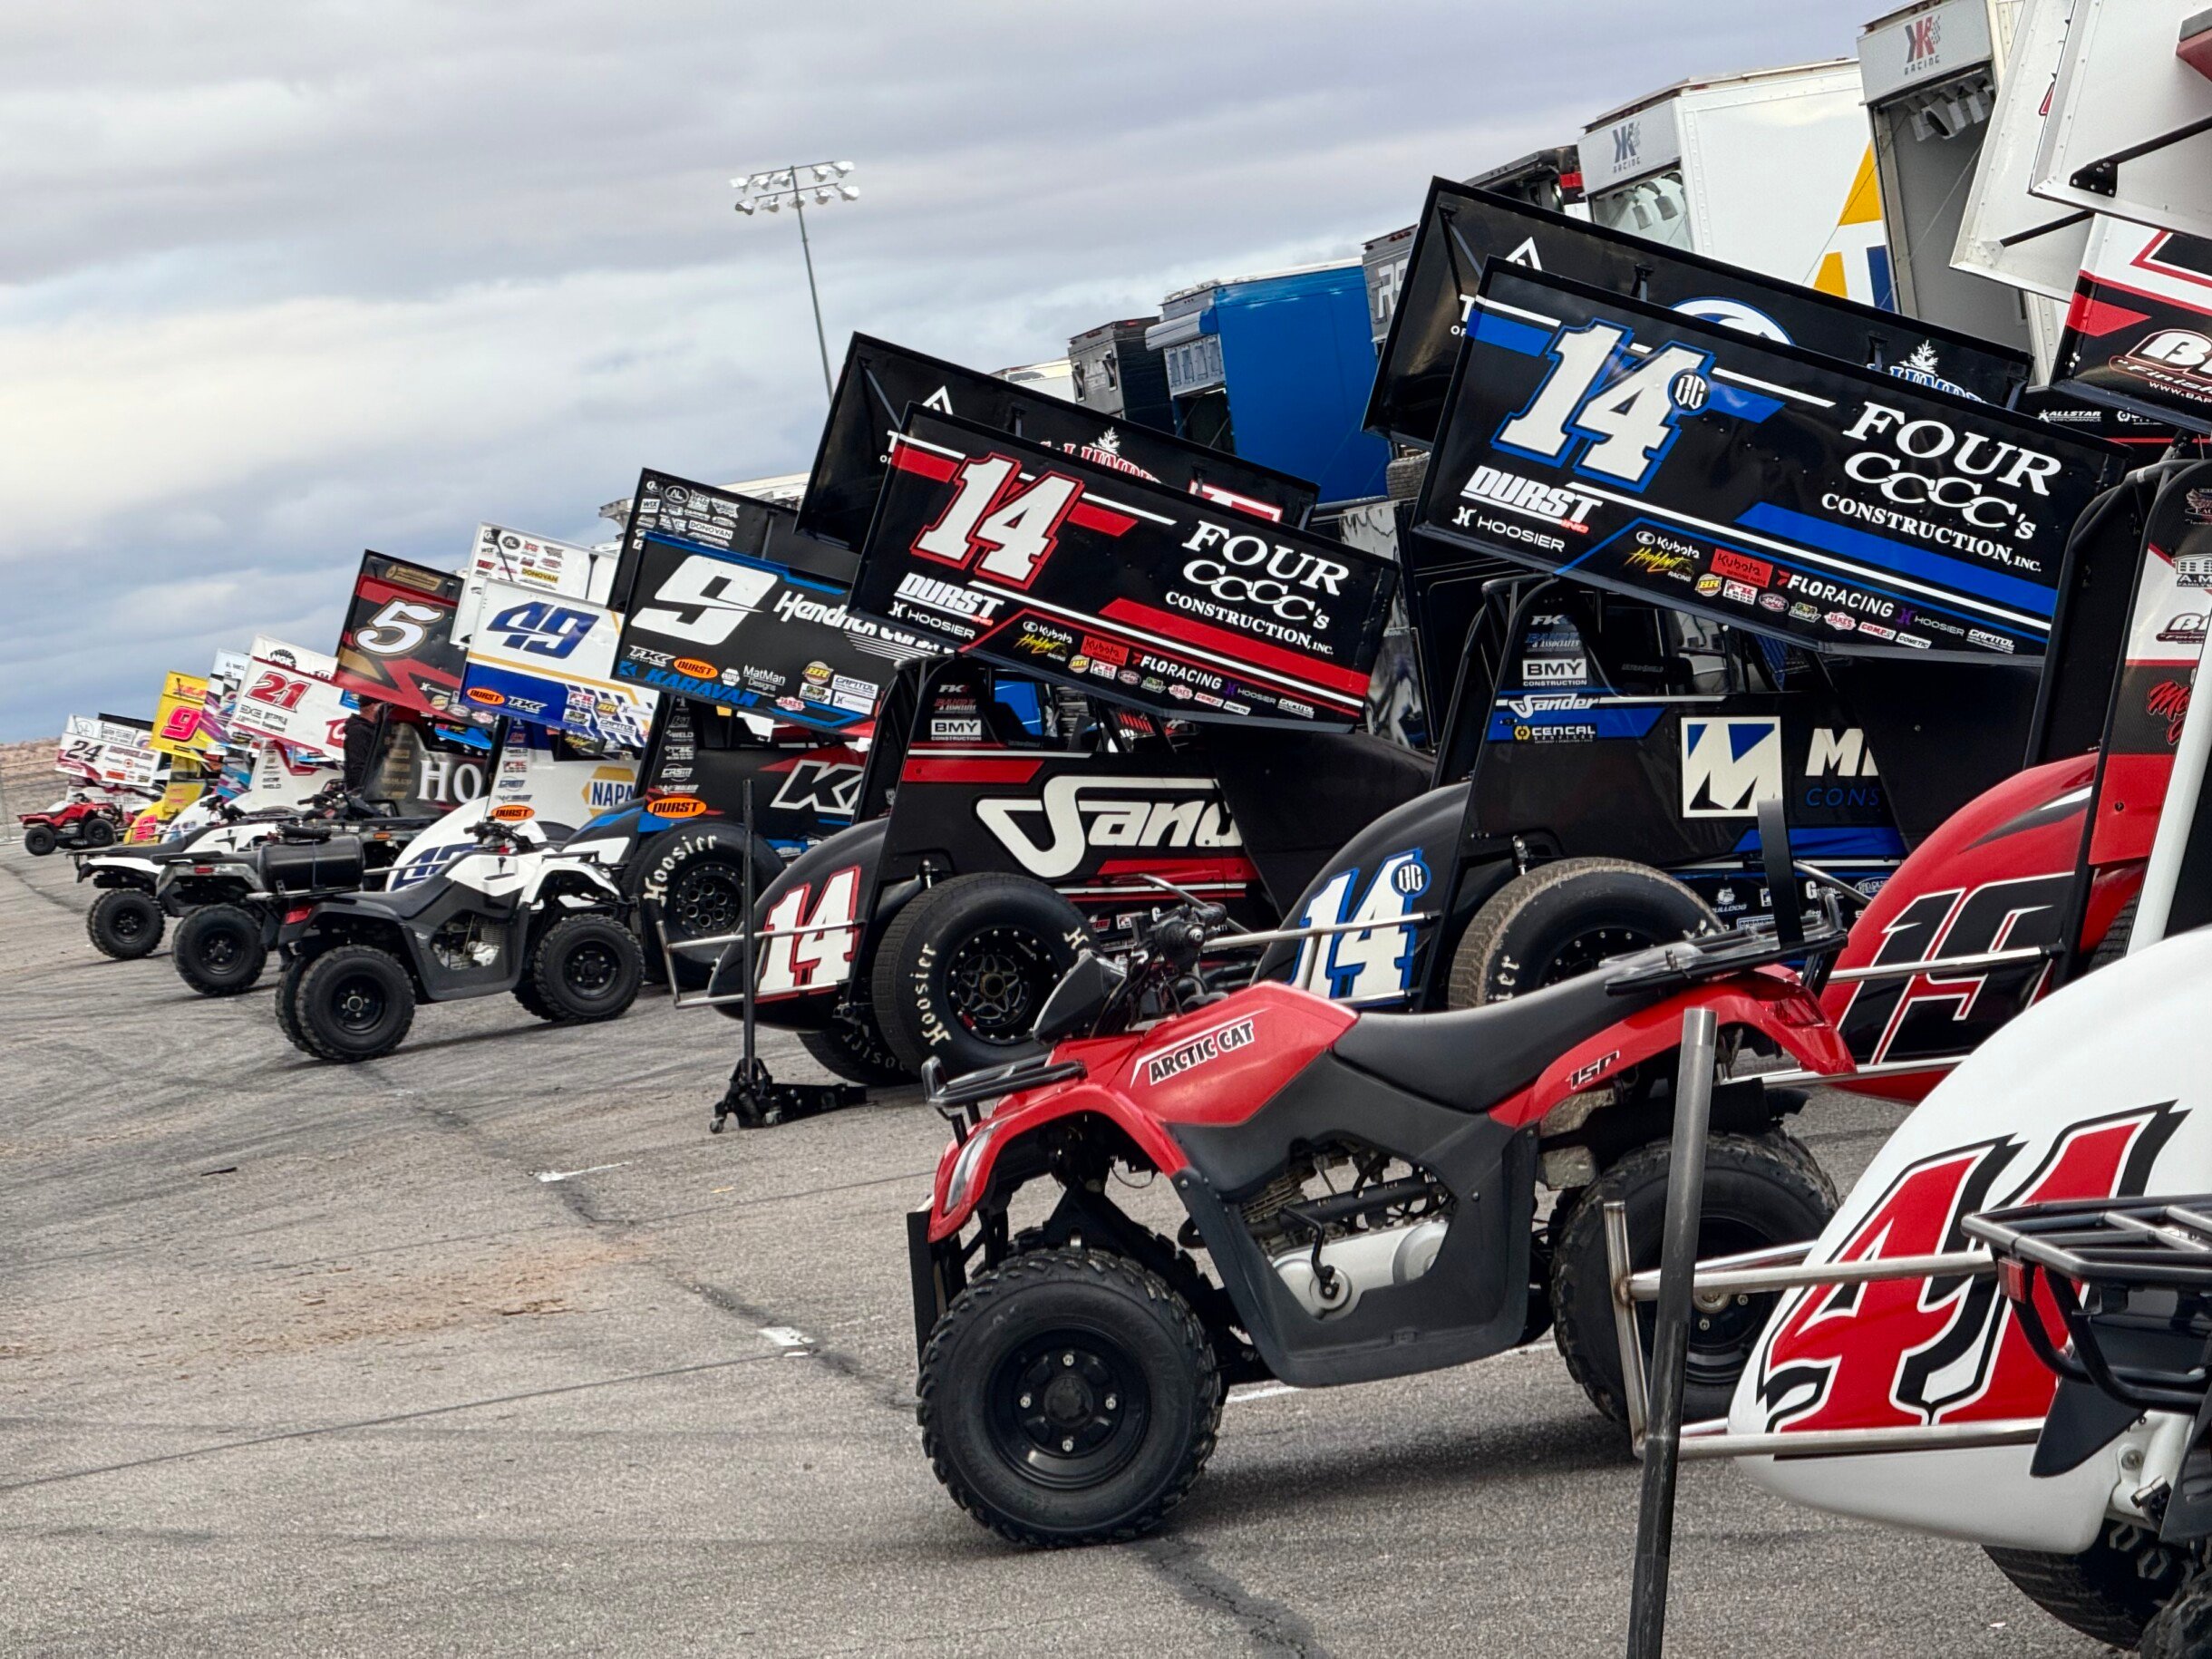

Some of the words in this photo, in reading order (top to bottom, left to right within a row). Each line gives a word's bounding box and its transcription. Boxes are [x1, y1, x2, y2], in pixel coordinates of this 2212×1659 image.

[1491, 318, 1716, 493] 14
[1843, 401, 2062, 497] FOUR
[1461, 465, 1604, 523] DURST
[690, 521, 732, 538] DONOVAN
[909, 452, 1086, 590] 14
[1477, 517, 1566, 552] HOOSIER
[1656, 536, 1700, 558] Kubota
[1181, 519, 1350, 597] FOUR
[1717, 553, 1762, 577] Kubota
[2014, 554, 2042, 572] INC.
[631, 555, 779, 645] 9
[894, 572, 1004, 619] DURST
[354, 595, 444, 655] 5
[486, 600, 600, 660] 49
[907, 610, 975, 640] HOOSIER
[1039, 625, 1073, 645] Kubota
[1915, 615, 1965, 636] HOOSIER
[1970, 628, 2015, 647] CAPITOL
[1312, 641, 1334, 655] INC.
[1898, 635, 1929, 648] COMETIC
[270, 655, 293, 667] NGK
[677, 660, 713, 675] DURST
[743, 664, 786, 684] MatMan
[1527, 662, 1583, 676] BMY
[245, 671, 312, 713] 21
[470, 689, 502, 703] DURST
[644, 668, 761, 708] KARAVAN
[1237, 687, 1276, 705] HOOSIER
[1509, 693, 1599, 719] Sander
[160, 705, 202, 742] 9
[935, 722, 978, 732] BMY
[64, 740, 105, 763] 24
[592, 781, 634, 807] NAPA
[653, 801, 701, 813] DURST
[495, 809, 529, 817] DURST
[755, 864, 861, 1002] 14
[1286, 847, 1425, 1008] 14
[1150, 1035, 1218, 1084] ARCTIC
[1218, 1020, 1255, 1053] CAT
[1756, 1099, 2192, 1433] 41
